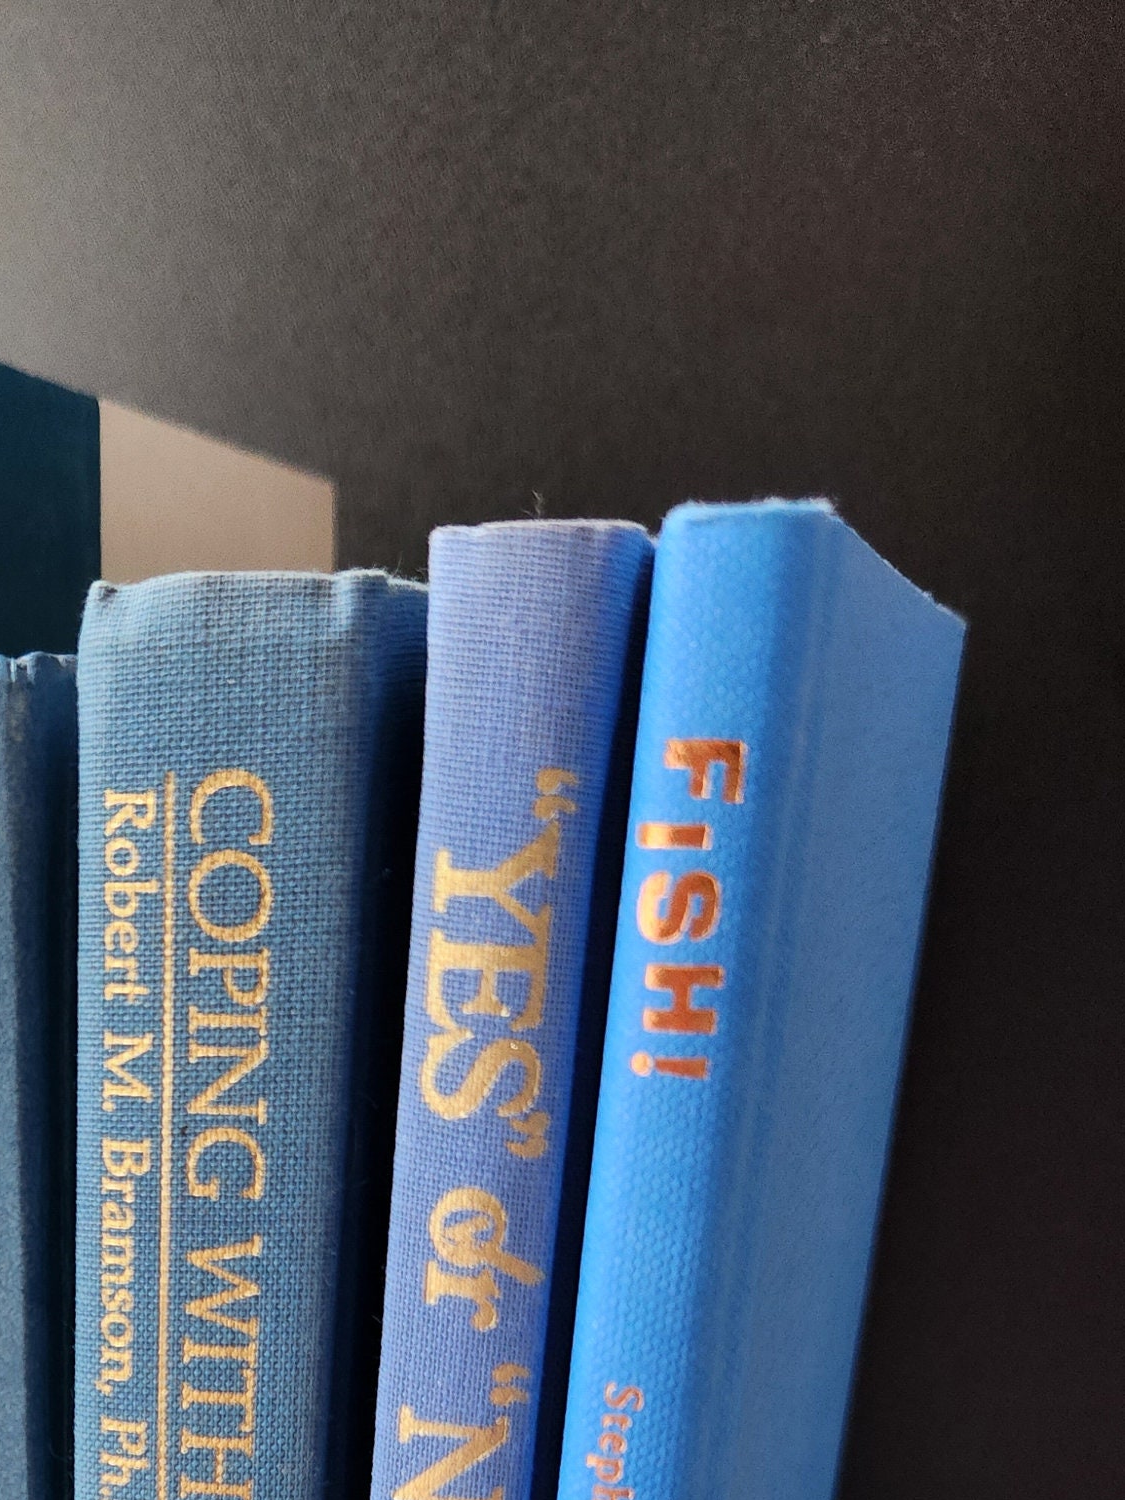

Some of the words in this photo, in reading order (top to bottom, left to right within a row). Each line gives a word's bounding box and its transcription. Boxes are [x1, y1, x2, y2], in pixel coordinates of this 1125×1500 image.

[102, 788, 159, 1001] Robert
[186, 767, 275, 1202] COPING
[629, 738, 749, 1081] FISH!
[100, 1030, 155, 1112] M.
[99, 1138, 153, 1397] Bramson,
